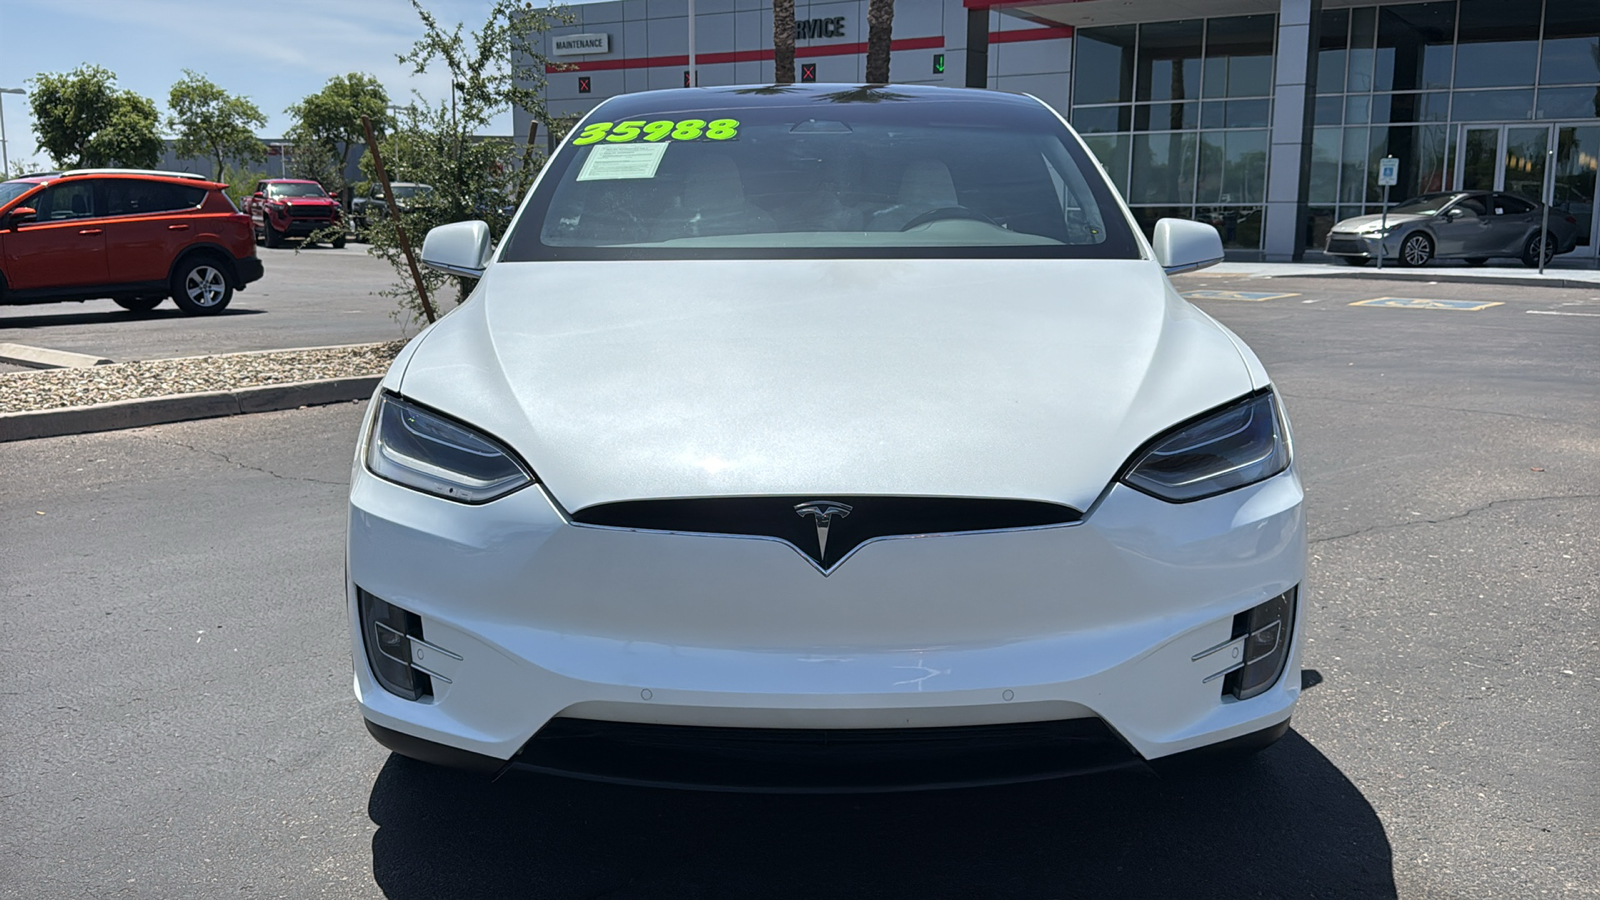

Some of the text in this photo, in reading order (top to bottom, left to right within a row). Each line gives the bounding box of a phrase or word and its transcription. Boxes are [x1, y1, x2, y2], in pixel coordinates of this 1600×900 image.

[794, 16, 845, 39] RVICE
[556, 39, 602, 49] MAINTENANCE
[572, 119, 740, 146] 35988
